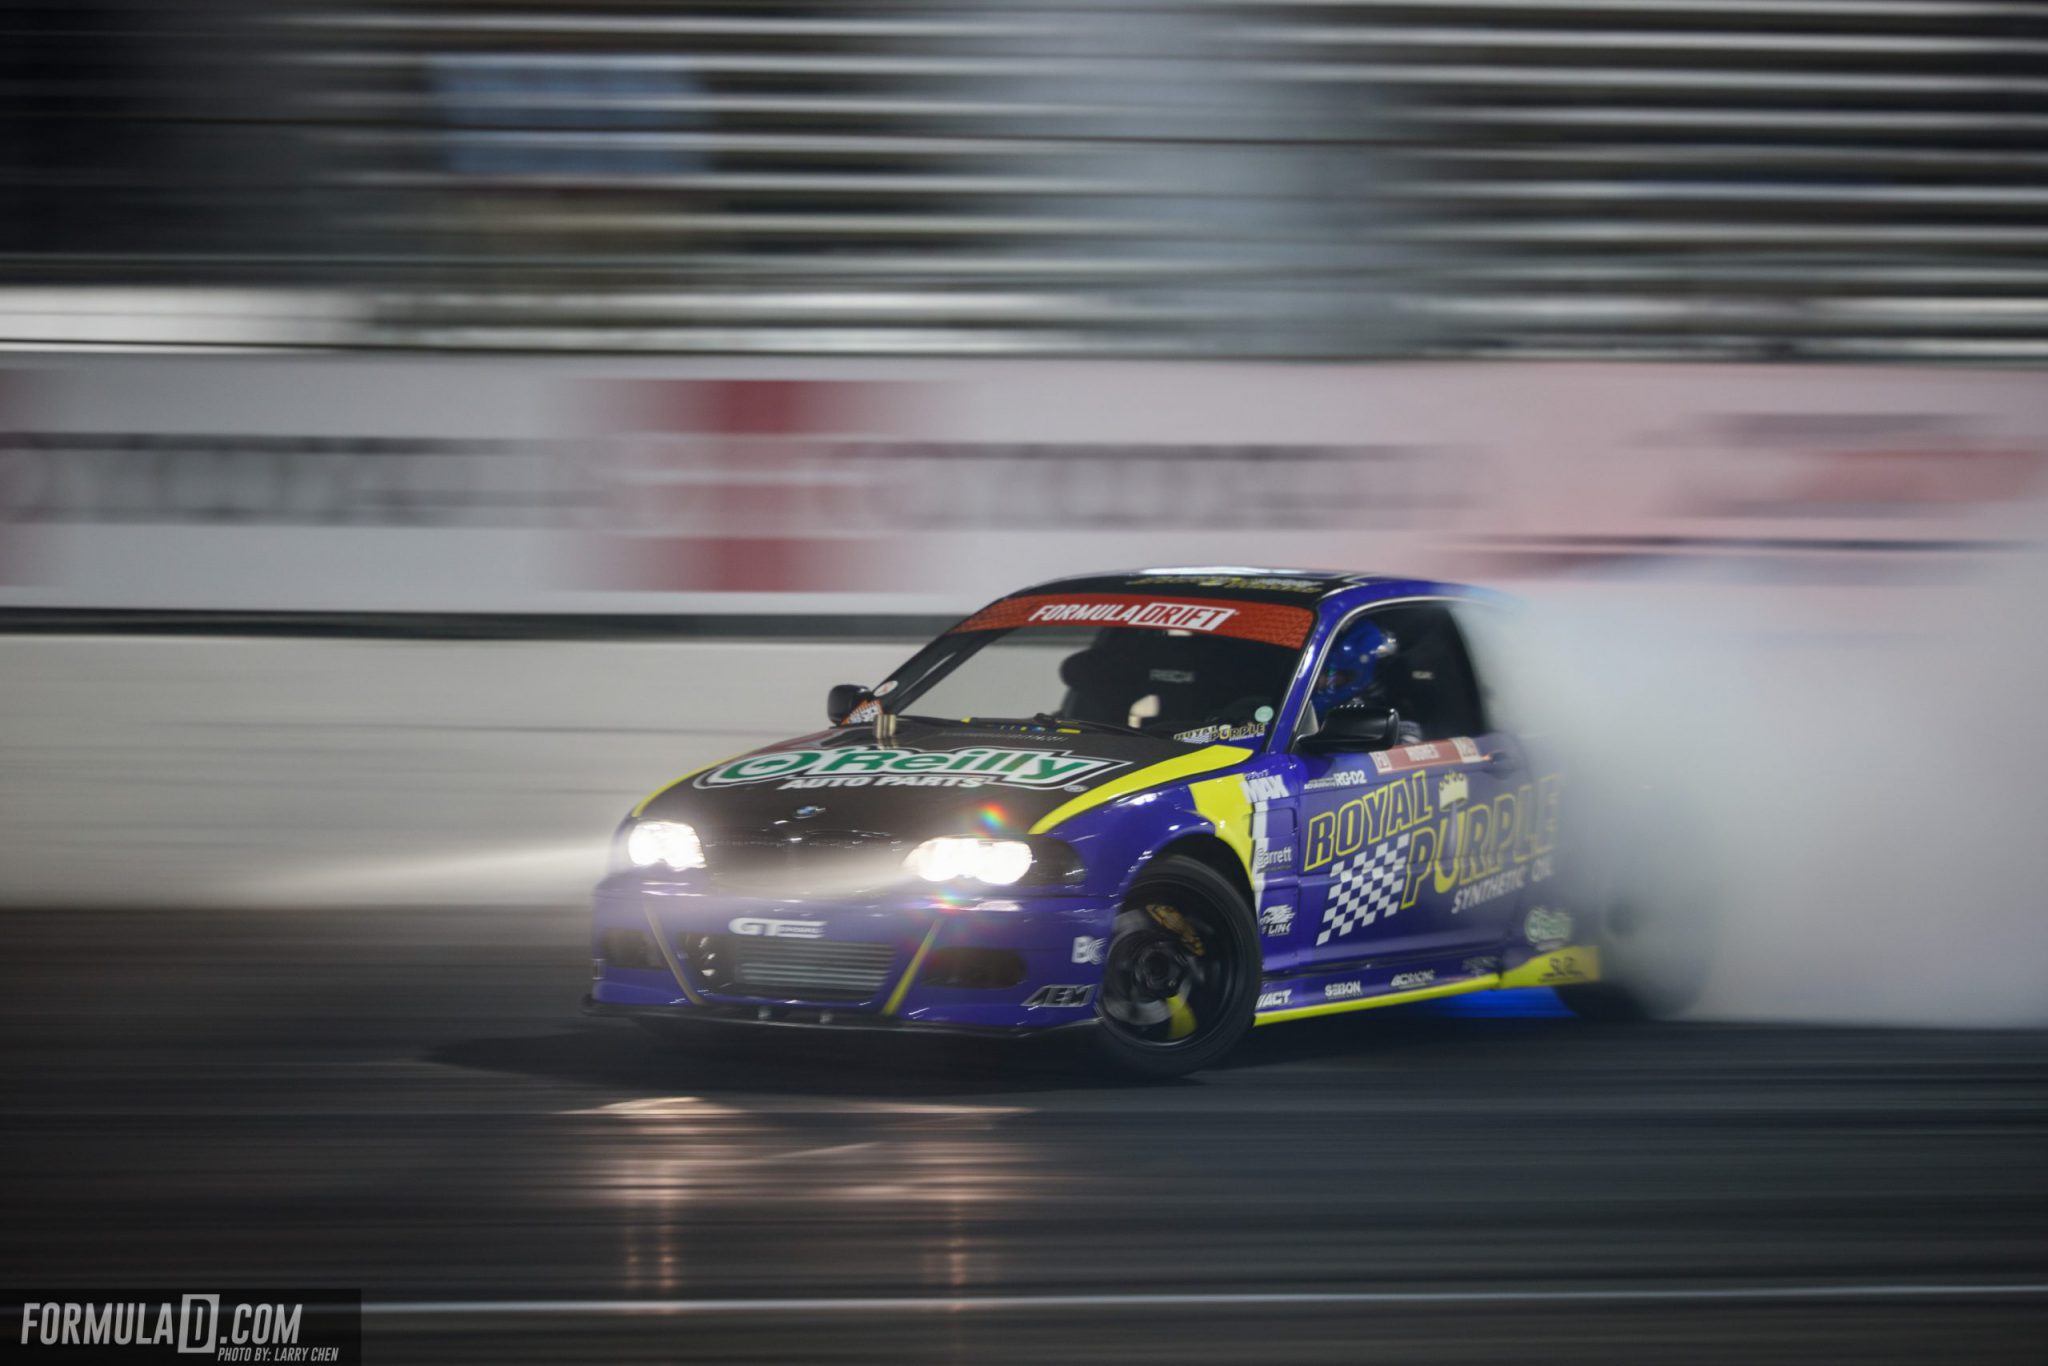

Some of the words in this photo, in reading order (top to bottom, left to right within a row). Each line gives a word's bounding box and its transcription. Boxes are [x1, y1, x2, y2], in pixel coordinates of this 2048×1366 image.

[706, 746, 1098, 783] O'Reilly
[777, 775, 871, 790] AUTO
[873, 774, 987, 789] PARTS
[1303, 769, 1433, 872] ROYAL
[1399, 774, 1564, 910] PURPLE
[1451, 867, 1526, 914] SYNTHETIC
[1324, 981, 1362, 998] SEBON
